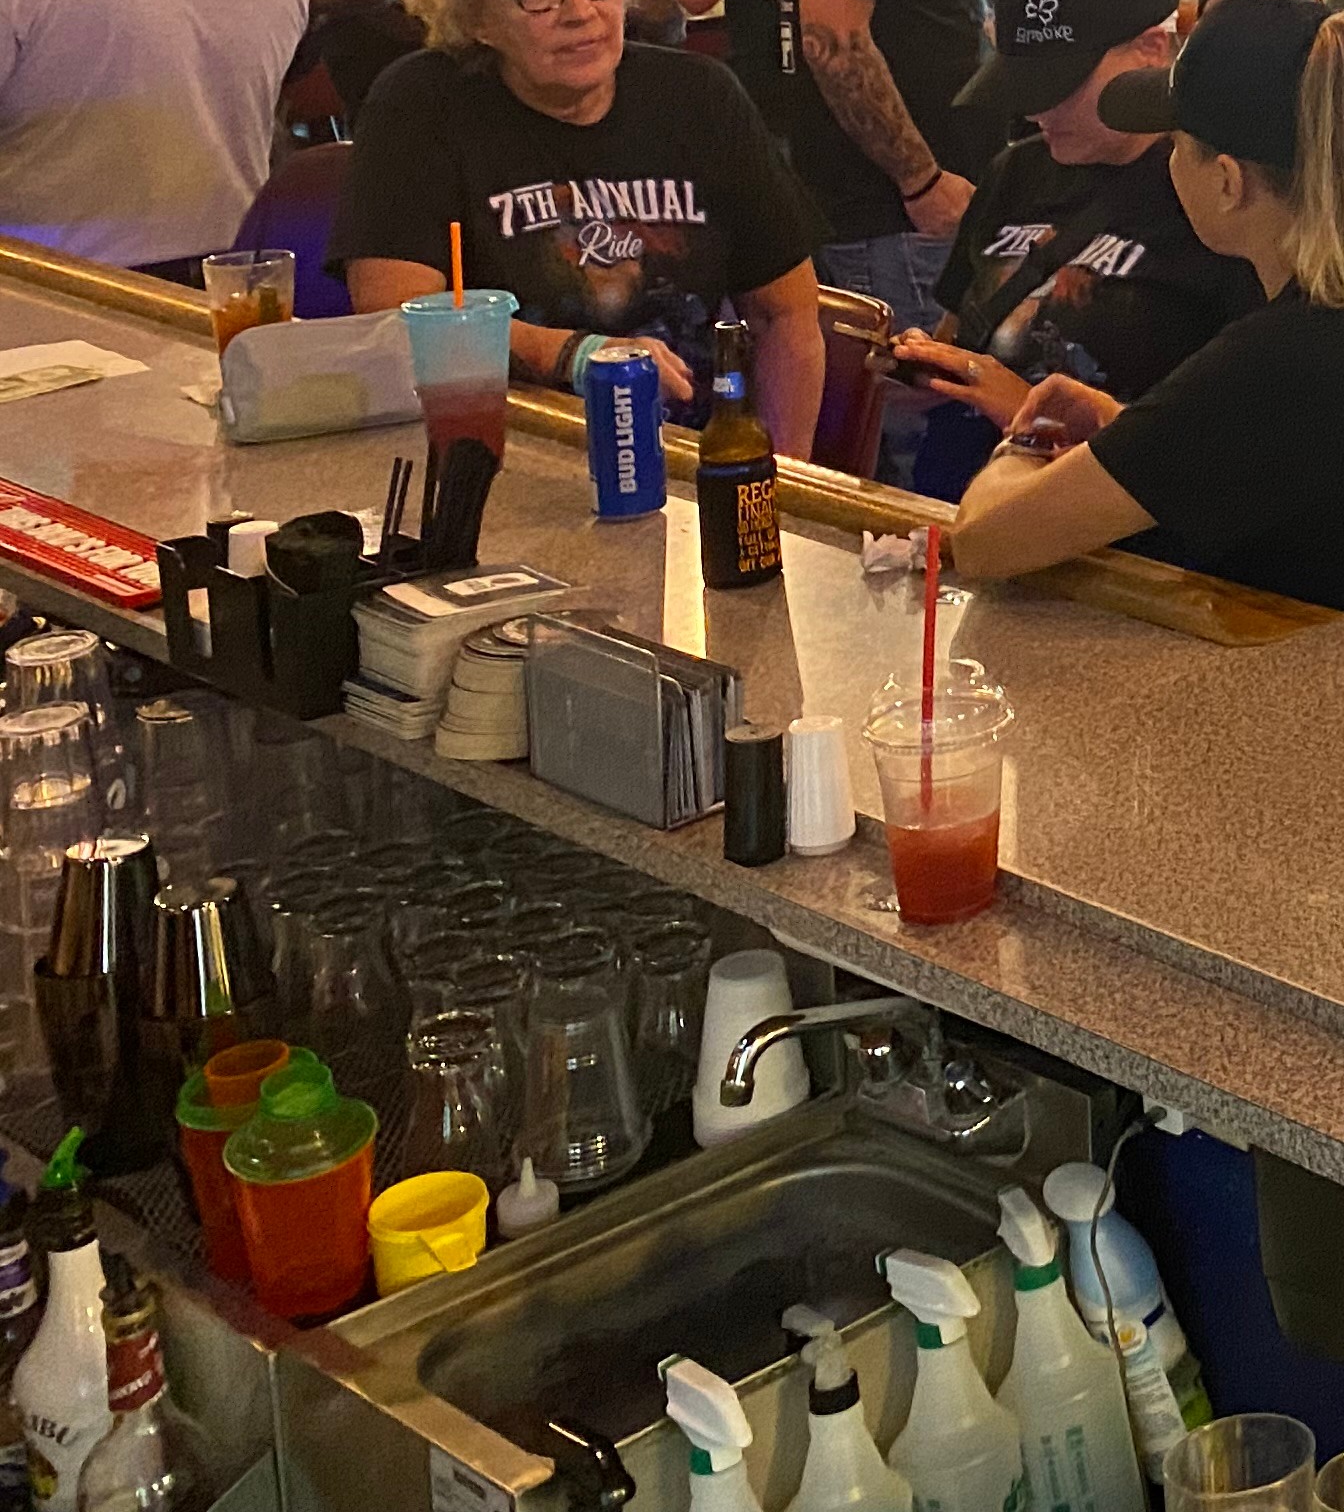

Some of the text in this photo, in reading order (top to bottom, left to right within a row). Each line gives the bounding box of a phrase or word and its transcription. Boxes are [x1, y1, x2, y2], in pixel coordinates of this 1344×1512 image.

[488, 178, 706, 238] 7TH ANNUAL
[578, 219, 644, 268] Ride
[613, 384, 638, 494] BUD LIGHT
